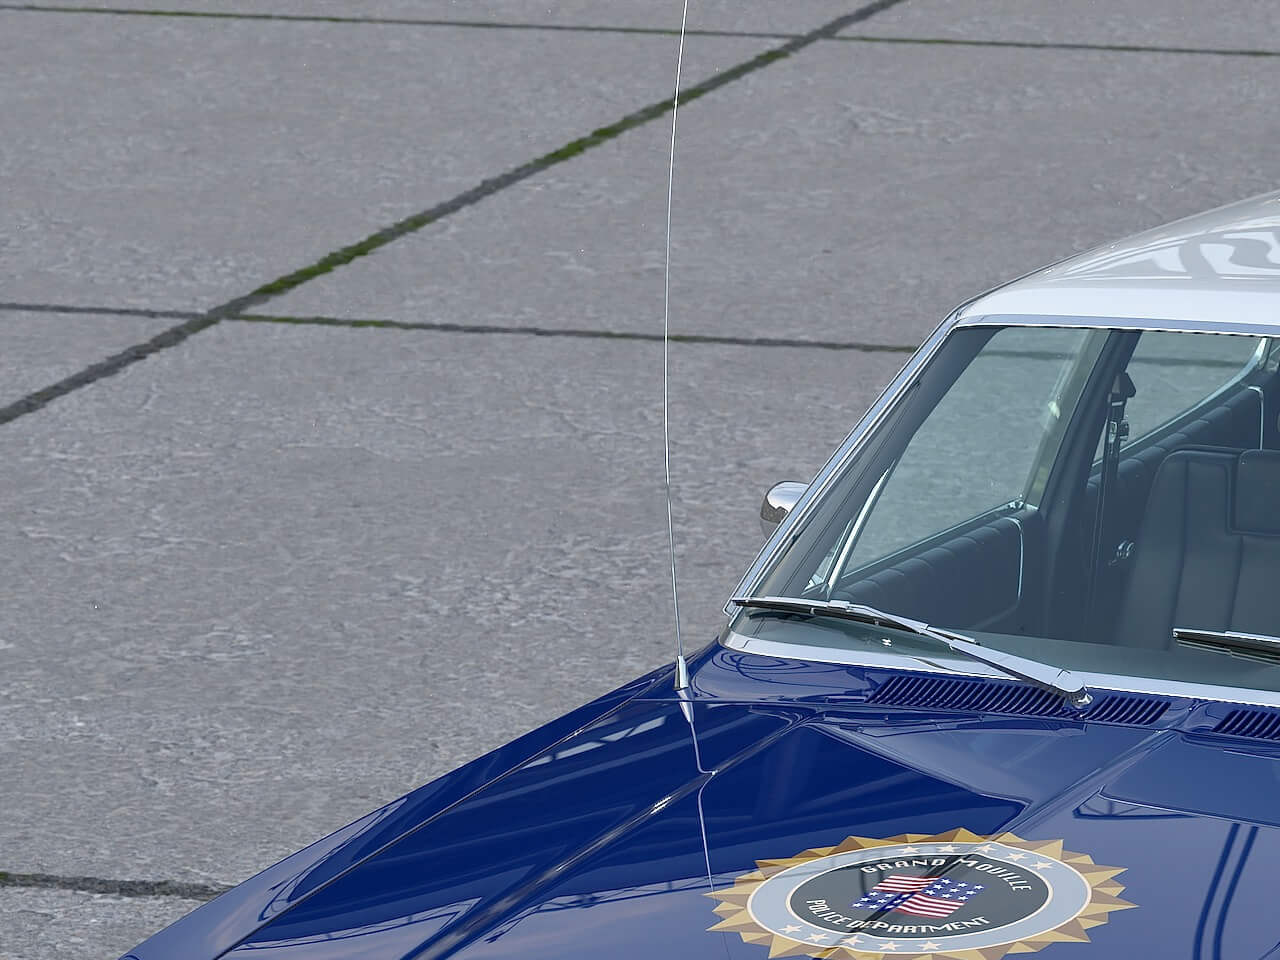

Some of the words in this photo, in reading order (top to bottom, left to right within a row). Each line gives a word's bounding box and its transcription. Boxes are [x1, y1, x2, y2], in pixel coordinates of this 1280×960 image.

[860, 857, 946, 874] GRAND
[806, 898, 852, 926] POLICE
[847, 915, 991, 935] DEPARTMENT
